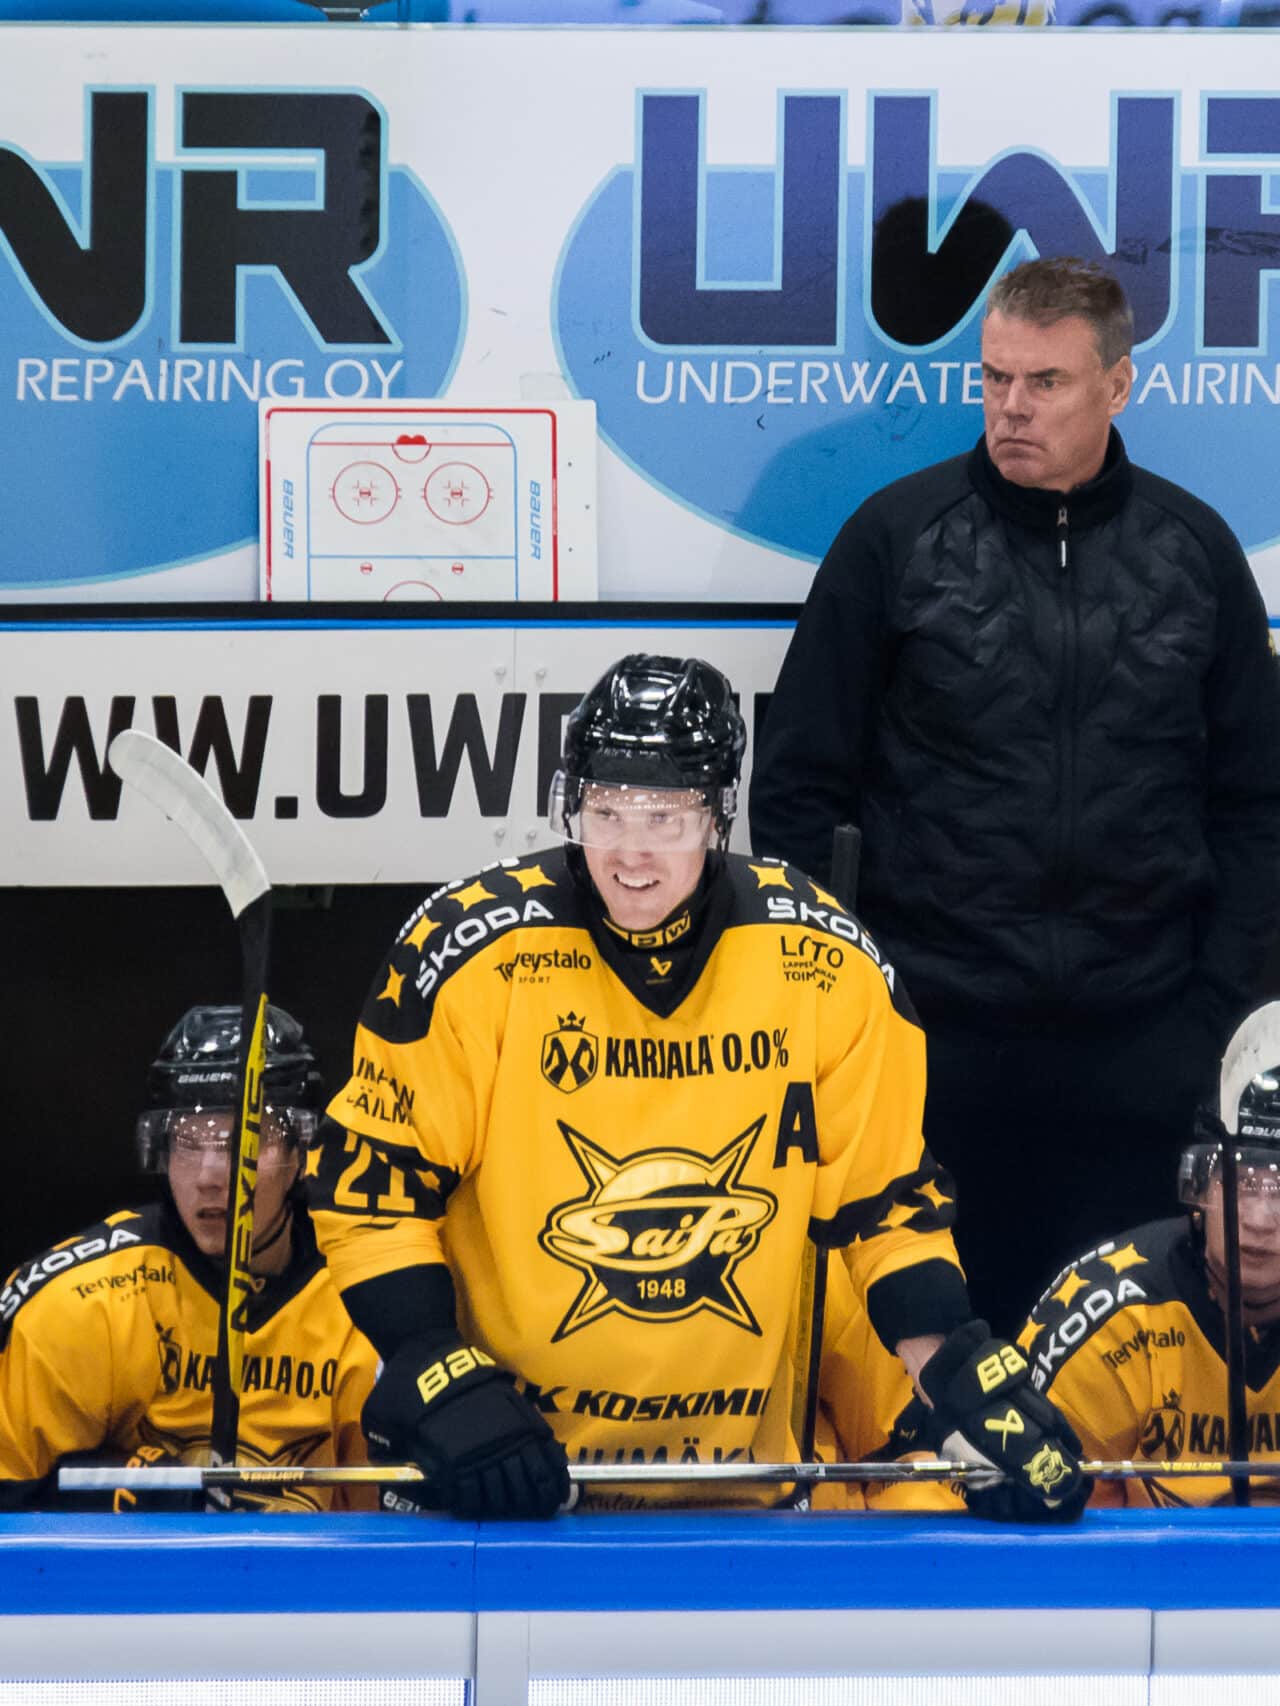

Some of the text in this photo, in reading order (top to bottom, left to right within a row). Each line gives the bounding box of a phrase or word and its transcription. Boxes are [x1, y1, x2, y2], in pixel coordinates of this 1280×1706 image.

[16, 358, 405, 402] REPAIRING OY
[635, 361, 984, 405] UNDERWATE
[604, 1027, 789, 1080] KARJALA 0.0%
[772, 1081, 821, 1169] A
[333, 1129, 416, 1213] 21
[636, 1278, 686, 1299] 1948
[571, 1387, 772, 1422] KOSKIMI
